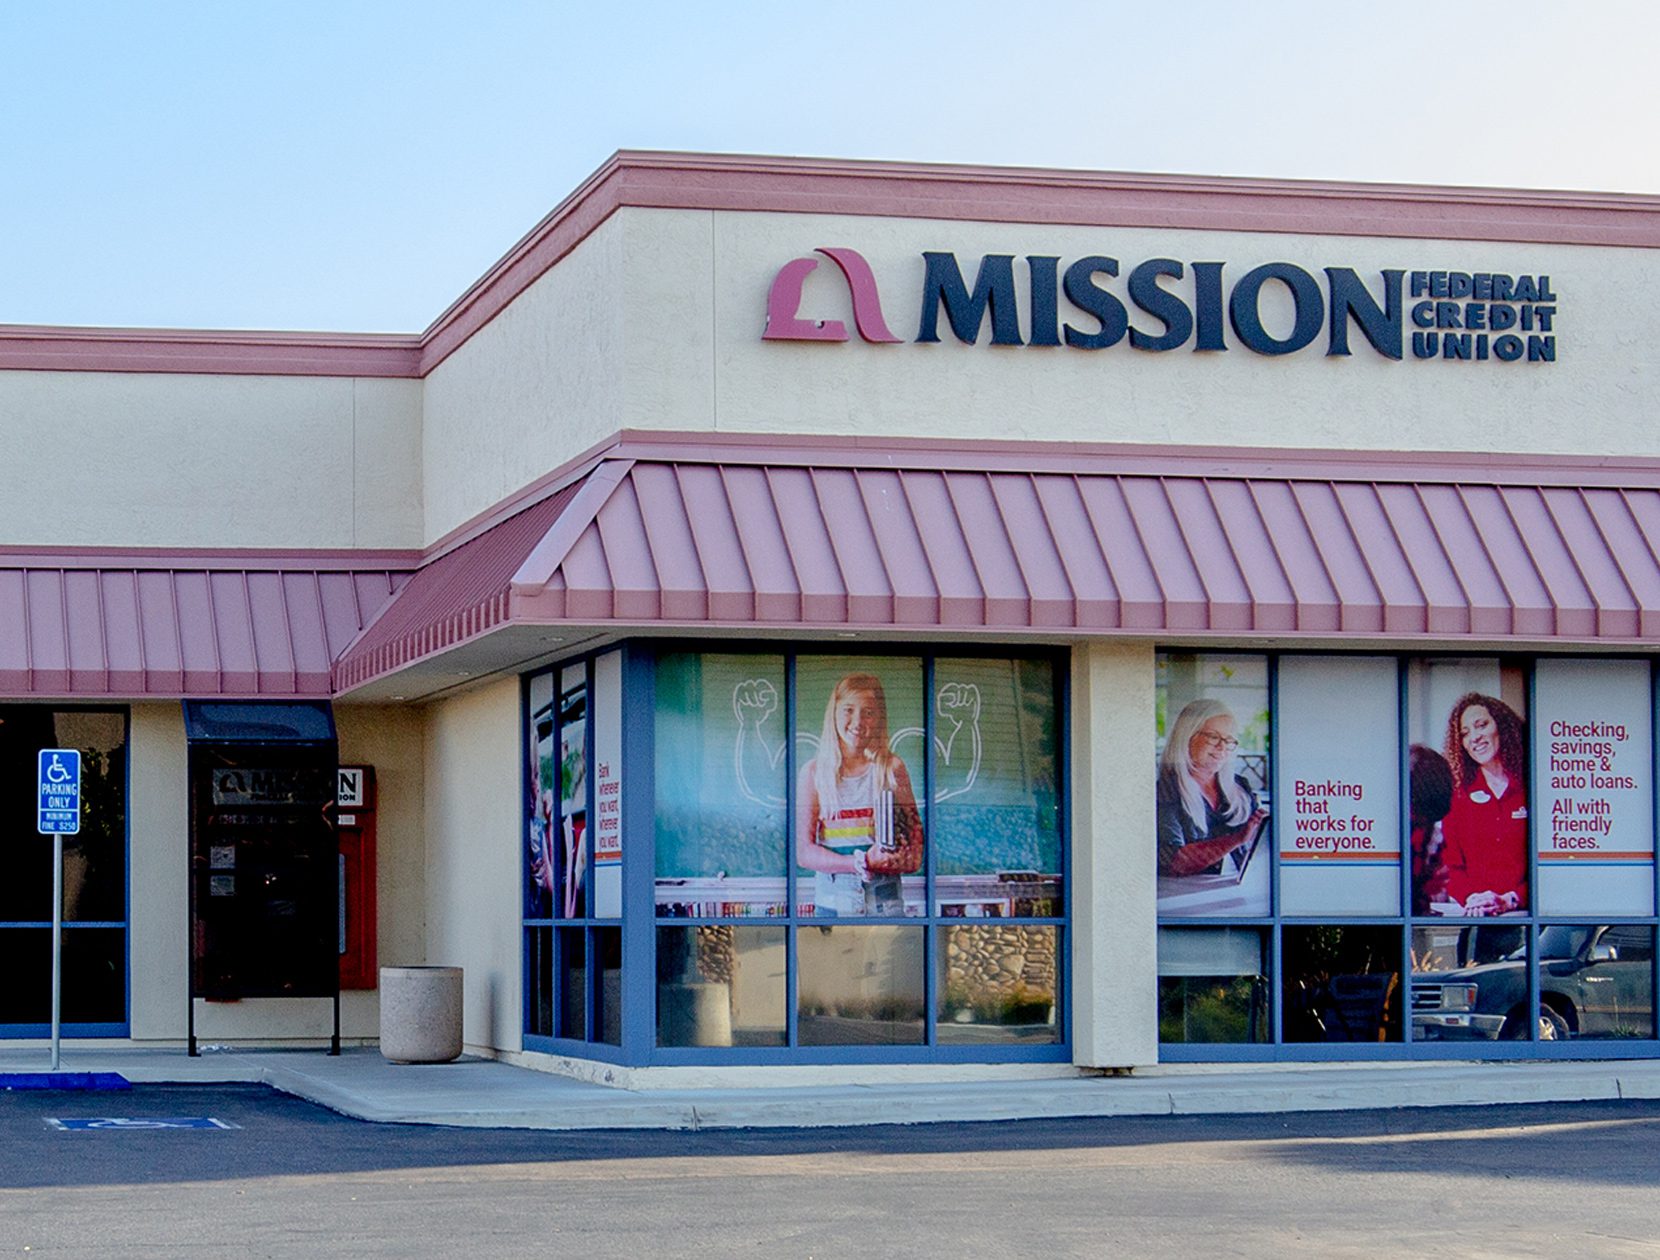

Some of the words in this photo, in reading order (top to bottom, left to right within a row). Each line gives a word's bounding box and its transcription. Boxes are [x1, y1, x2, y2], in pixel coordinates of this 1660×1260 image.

[1411, 271, 1556, 302] FEDERAL
[914, 251, 1407, 361] MISSION
[1411, 301, 1556, 331] CREDIT
[1412, 332, 1556, 361] UNION
[1550, 721, 1629, 741] Checking,
[1551, 739, 1616, 758] savings,
[1550, 755, 1596, 771] home
[1600, 756, 1611, 771] &
[42, 783, 78, 796] PARKING
[1295, 779, 1363, 800] Banking
[1551, 774, 1586, 789] auto
[1590, 773, 1638, 789] loans.
[48, 796, 71, 808] ONLY
[1296, 798, 1328, 814] that
[1552, 799, 1572, 814] All
[1577, 798, 1611, 814] with
[42, 821, 55, 830] FINE
[1296, 815, 1346, 831] works
[1350, 815, 1374, 831] for
[1552, 815, 1612, 836] friendly
[1296, 836, 1376, 853] everyone.
[1552, 832, 1600, 849] faces.
